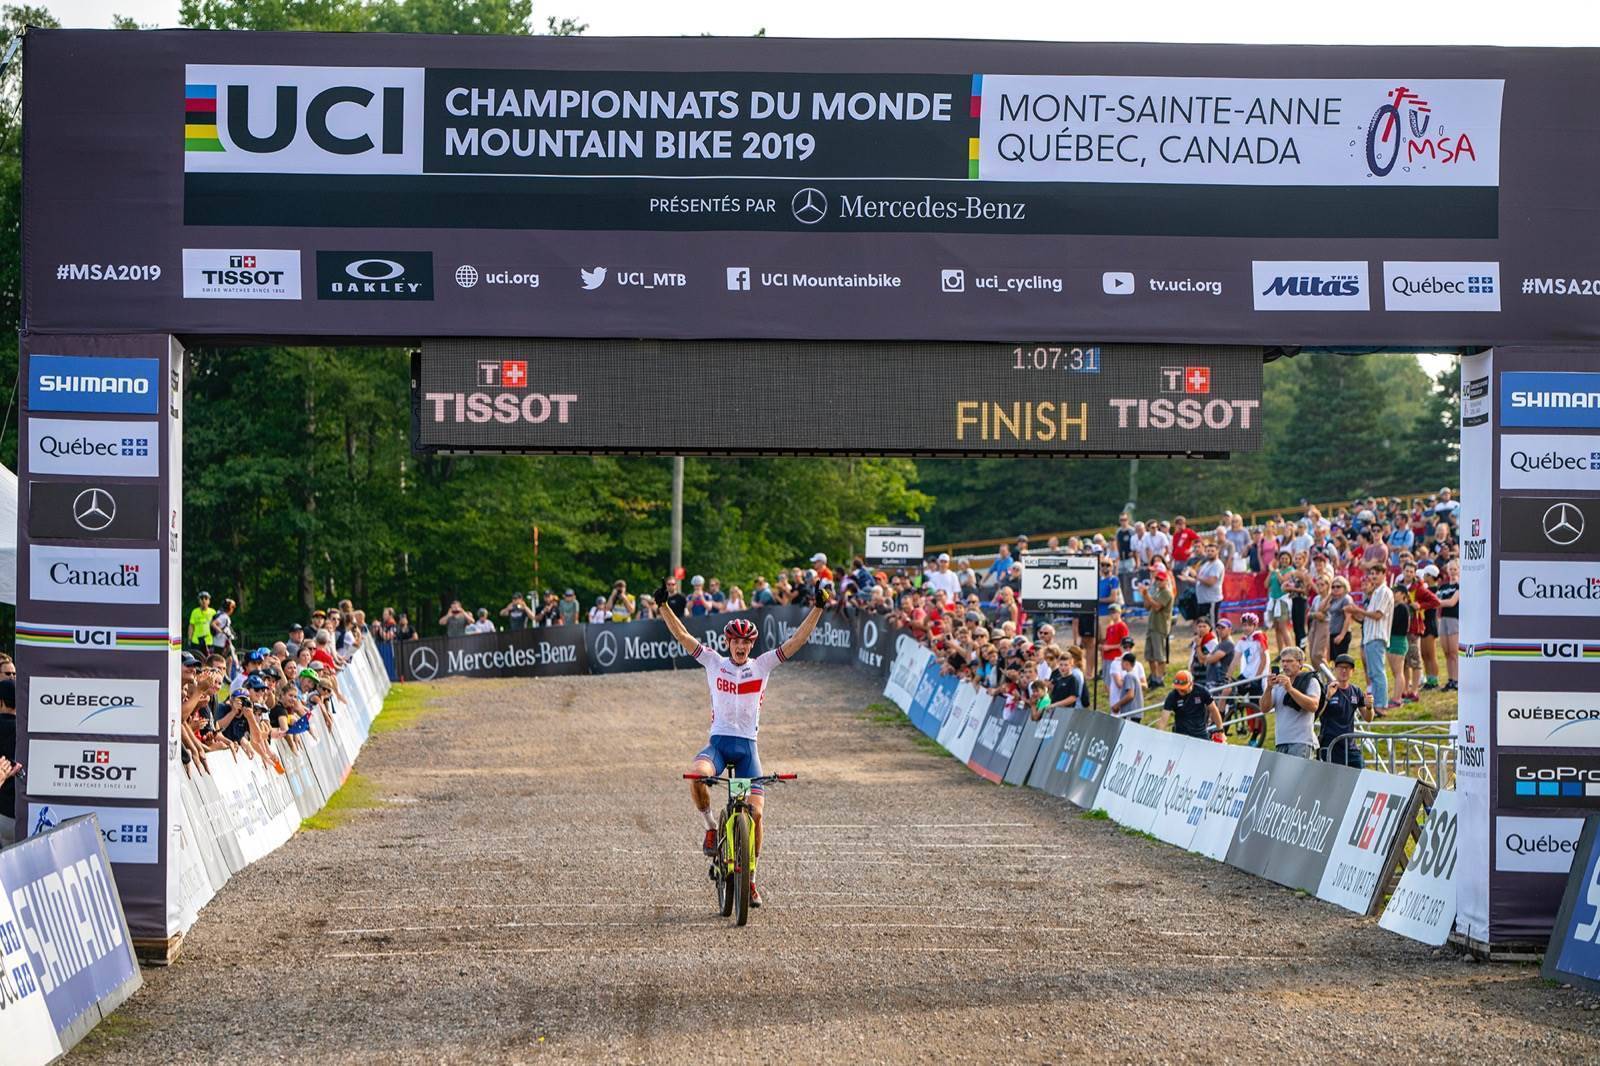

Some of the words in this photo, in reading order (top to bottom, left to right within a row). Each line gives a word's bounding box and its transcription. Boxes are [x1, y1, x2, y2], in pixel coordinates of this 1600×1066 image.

[445, 87, 739, 120] CHAMPIONNATS
[750, 91, 801, 121] DU
[812, 92, 952, 122] MONDE
[1000, 94, 1342, 126] MONT-SAINTE-ANNE
[227, 85, 404, 155] UCI
[445, 128, 644, 159] MOUNTAIN
[656, 131, 732, 160] BIKE
[742, 132, 816, 162] 2019
[998, 127, 1147, 167] QUÉBEC,
[1159, 136, 1301, 165] CANADA
[1408, 133, 1476, 164] MSA
[650, 196, 741, 214] PRÉSENTÉS
[746, 199, 776, 214] PAR
[840, 195, 1025, 221] Mercedes-Benz
[56, 264, 162, 282] #MSA2019
[202, 271, 284, 285] TISSOT
[486, 270, 540, 288] uci.org
[617, 272, 687, 288] UCI_MTB
[761, 273, 788, 288] UCI
[793, 273, 901, 289] Mountainbike
[975, 274, 1063, 293] uci_cycling
[331, 282, 419, 293] OAKLEY
[1149, 277, 1222, 296] tv.uci.org
[1262, 276, 1360, 297] Mitas
[1392, 275, 1465, 297] Québec
[1012, 347, 1099, 370] 1:07:31
[39, 375, 149, 394] SHIMANO
[425, 392, 578, 424] TISSOT
[1109, 398, 1260, 429] TISSOT
[955, 401, 1088, 441] FINISH
[39, 435, 118, 458] Québec
[1510, 451, 1587, 472] Québec
[881, 541, 909, 552] 50m
[1464, 539, 1486, 560] TISSOT
[49, 562, 140, 588] Canada
[1042, 573, 1078, 590] 25m
[75, 630, 112, 646] UCI
[447, 641, 577, 673] Mercedes-Benz
[1543, 643, 1579, 658] UCI
[716, 677, 737, 695] GBR
[39, 692, 135, 708] QUÉBECOR
[1507, 706, 1600, 720] QUÉBECOR
[1459, 744, 1485, 767] TISSOT
[54, 764, 137, 781] TISSOT
[1252, 787, 1335, 854] Mercedes-Benz
[12, 852, 123, 996] SHIMANO
